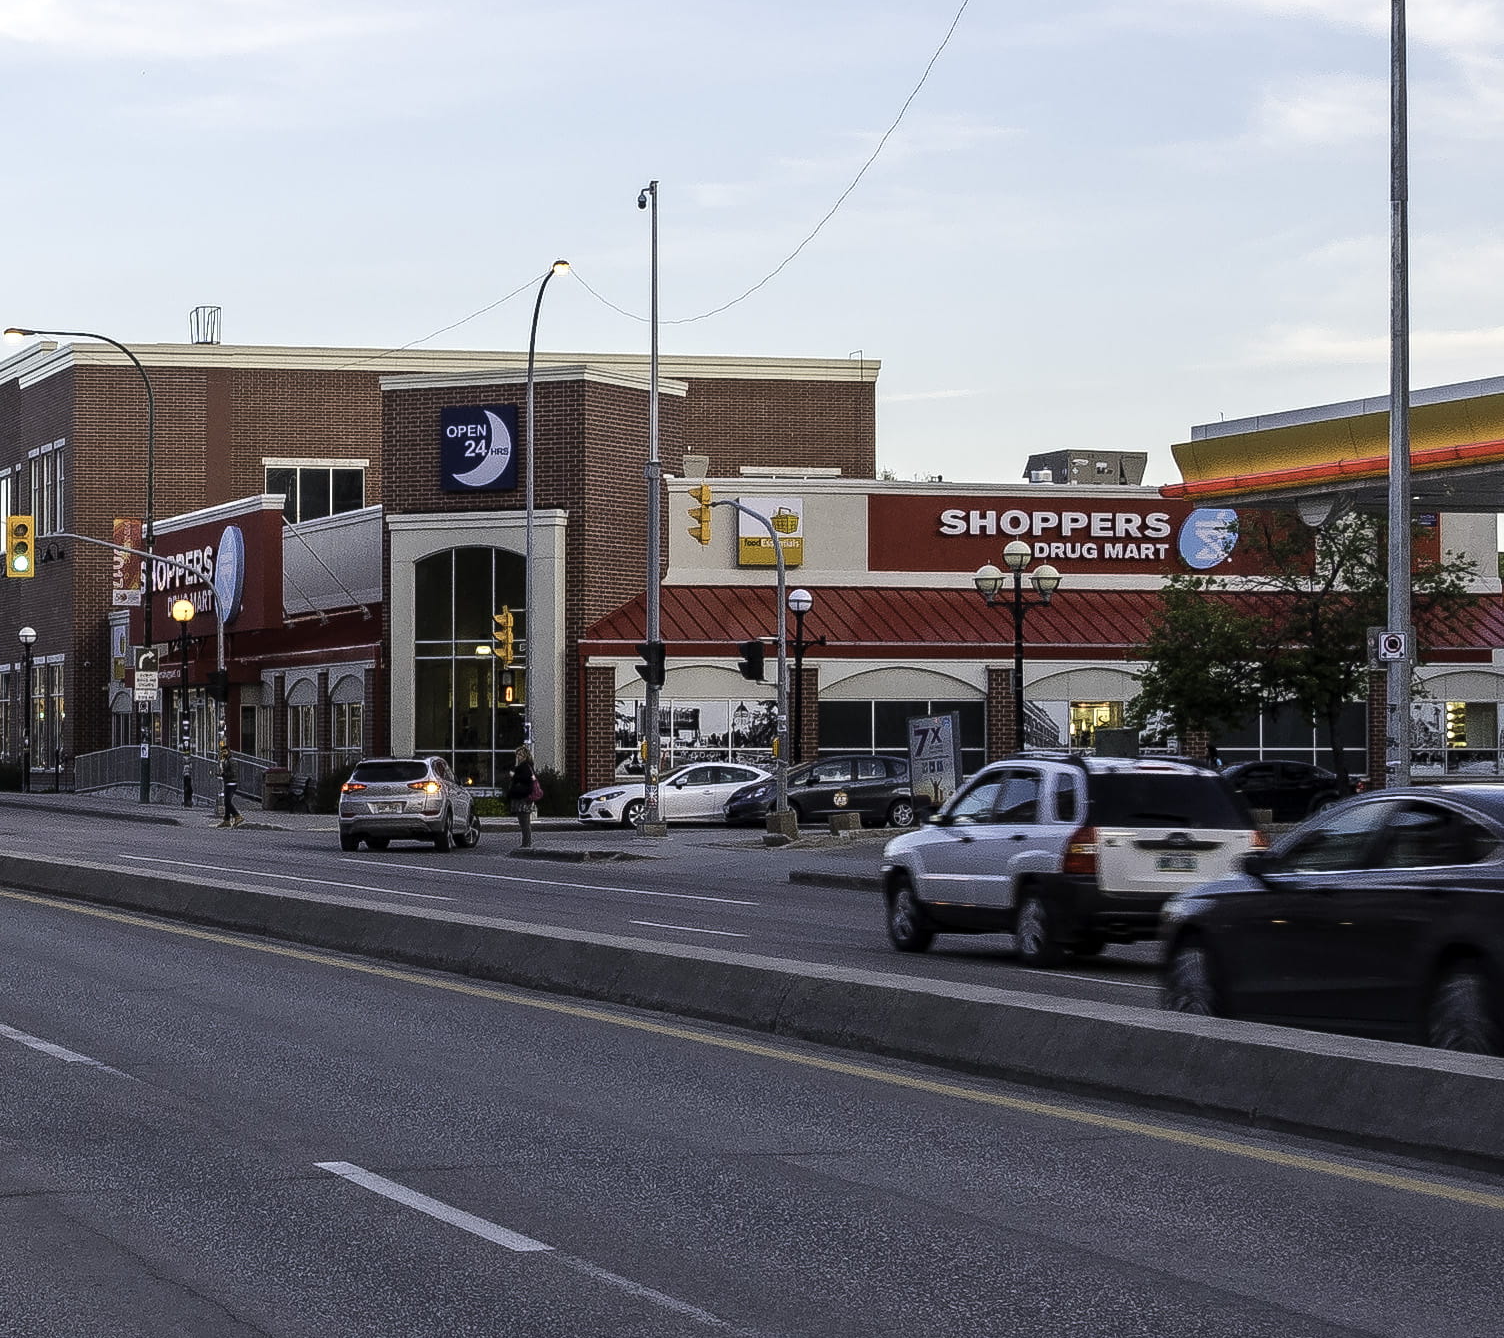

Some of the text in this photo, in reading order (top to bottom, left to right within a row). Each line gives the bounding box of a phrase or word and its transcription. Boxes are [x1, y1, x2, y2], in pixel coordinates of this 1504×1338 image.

[446, 424, 487, 438] OPEN
[464, 439, 509, 457] 24 HRS
[940, 510, 1171, 538] SHOPPERS
[1034, 542, 1170, 560] DRUG MART
